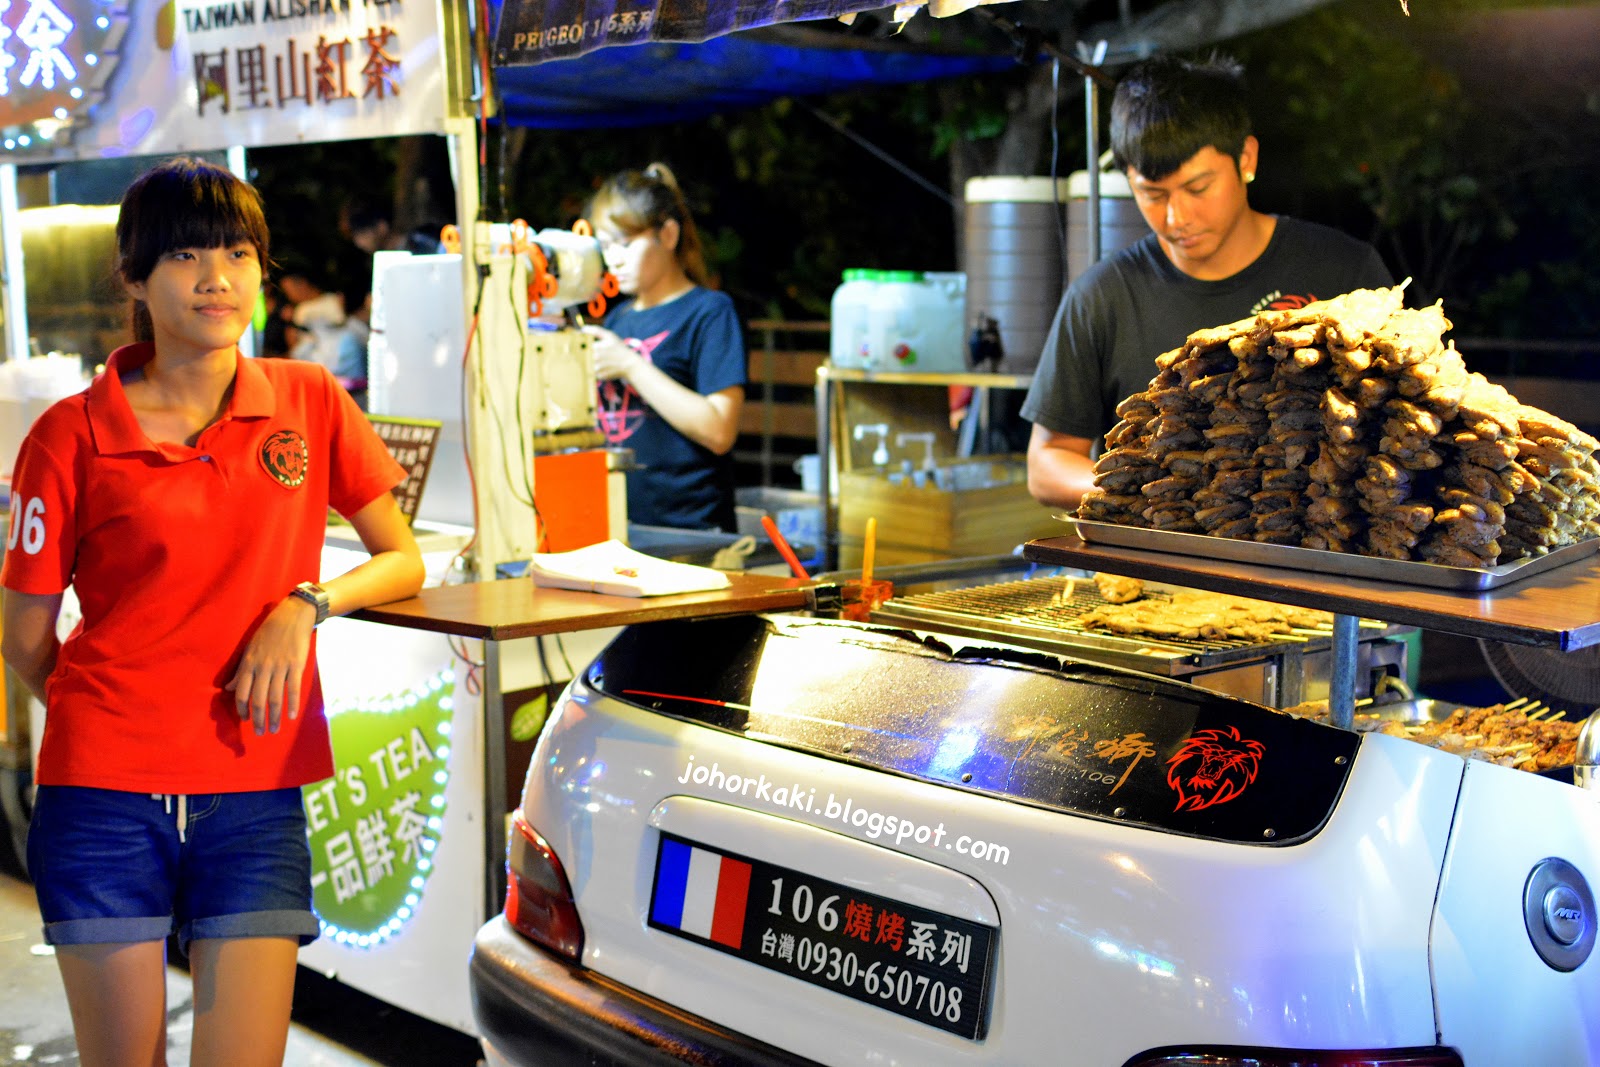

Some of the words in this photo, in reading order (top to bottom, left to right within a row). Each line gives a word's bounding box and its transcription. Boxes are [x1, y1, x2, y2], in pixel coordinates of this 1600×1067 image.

[183, 1, 255, 32] TAIWAN
[193, 26, 401, 116] 阿里山紅茶
[306, 766, 368, 838] ET'S
[369, 727, 434, 789] TEA
